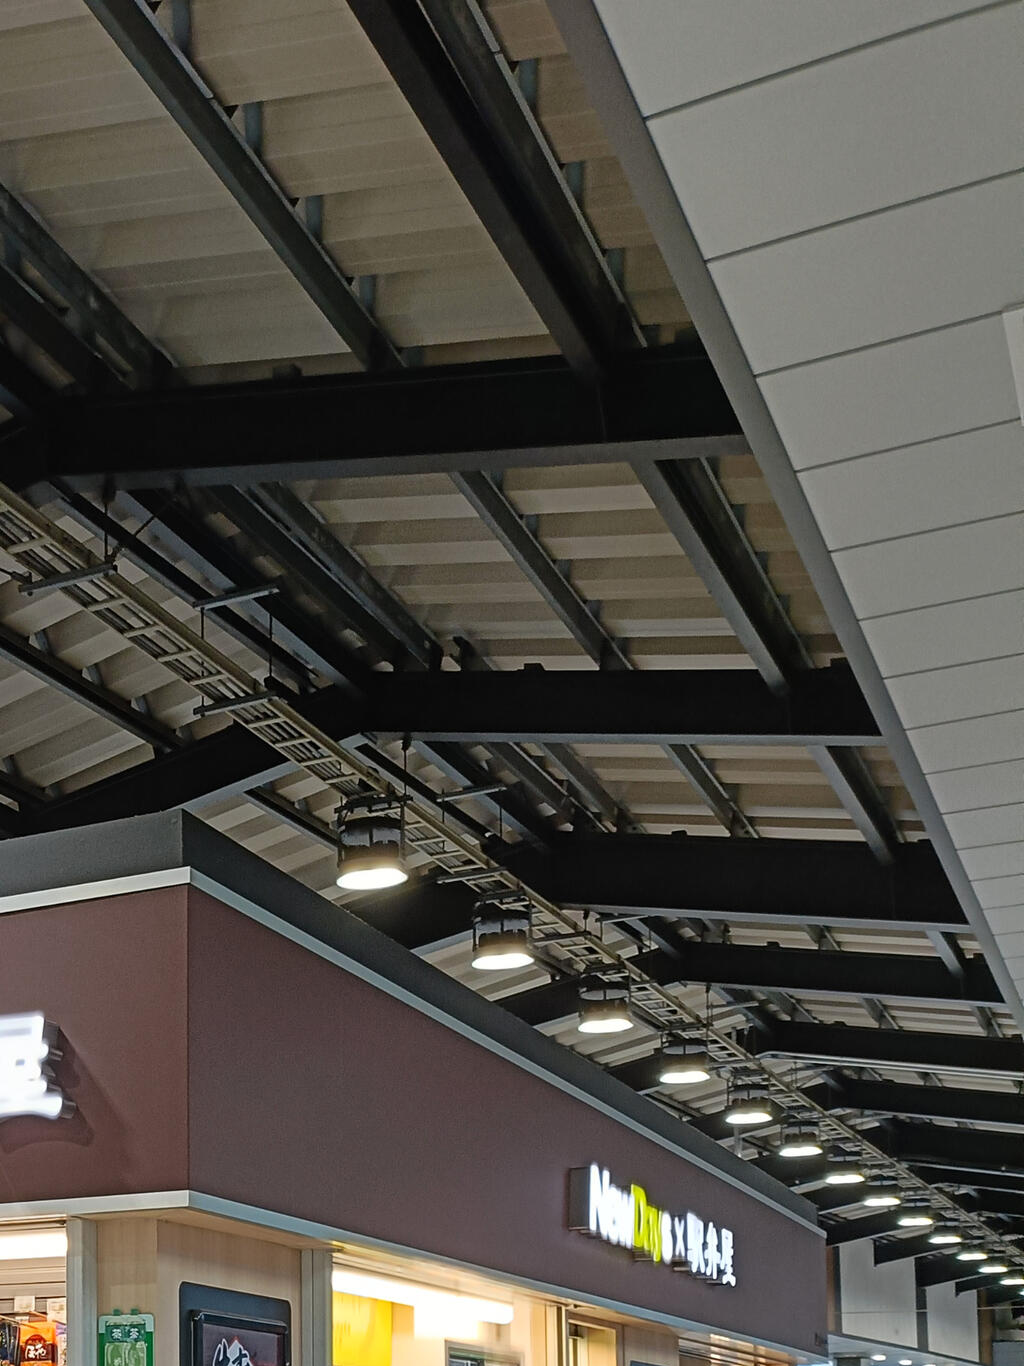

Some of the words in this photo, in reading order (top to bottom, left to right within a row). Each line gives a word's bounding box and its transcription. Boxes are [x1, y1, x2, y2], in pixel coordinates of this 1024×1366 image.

[686, 1211, 736, 1287] 駅弁屋
[111, 1328, 122, 1340] 茶
[129, 1327, 140, 1339] 茶
